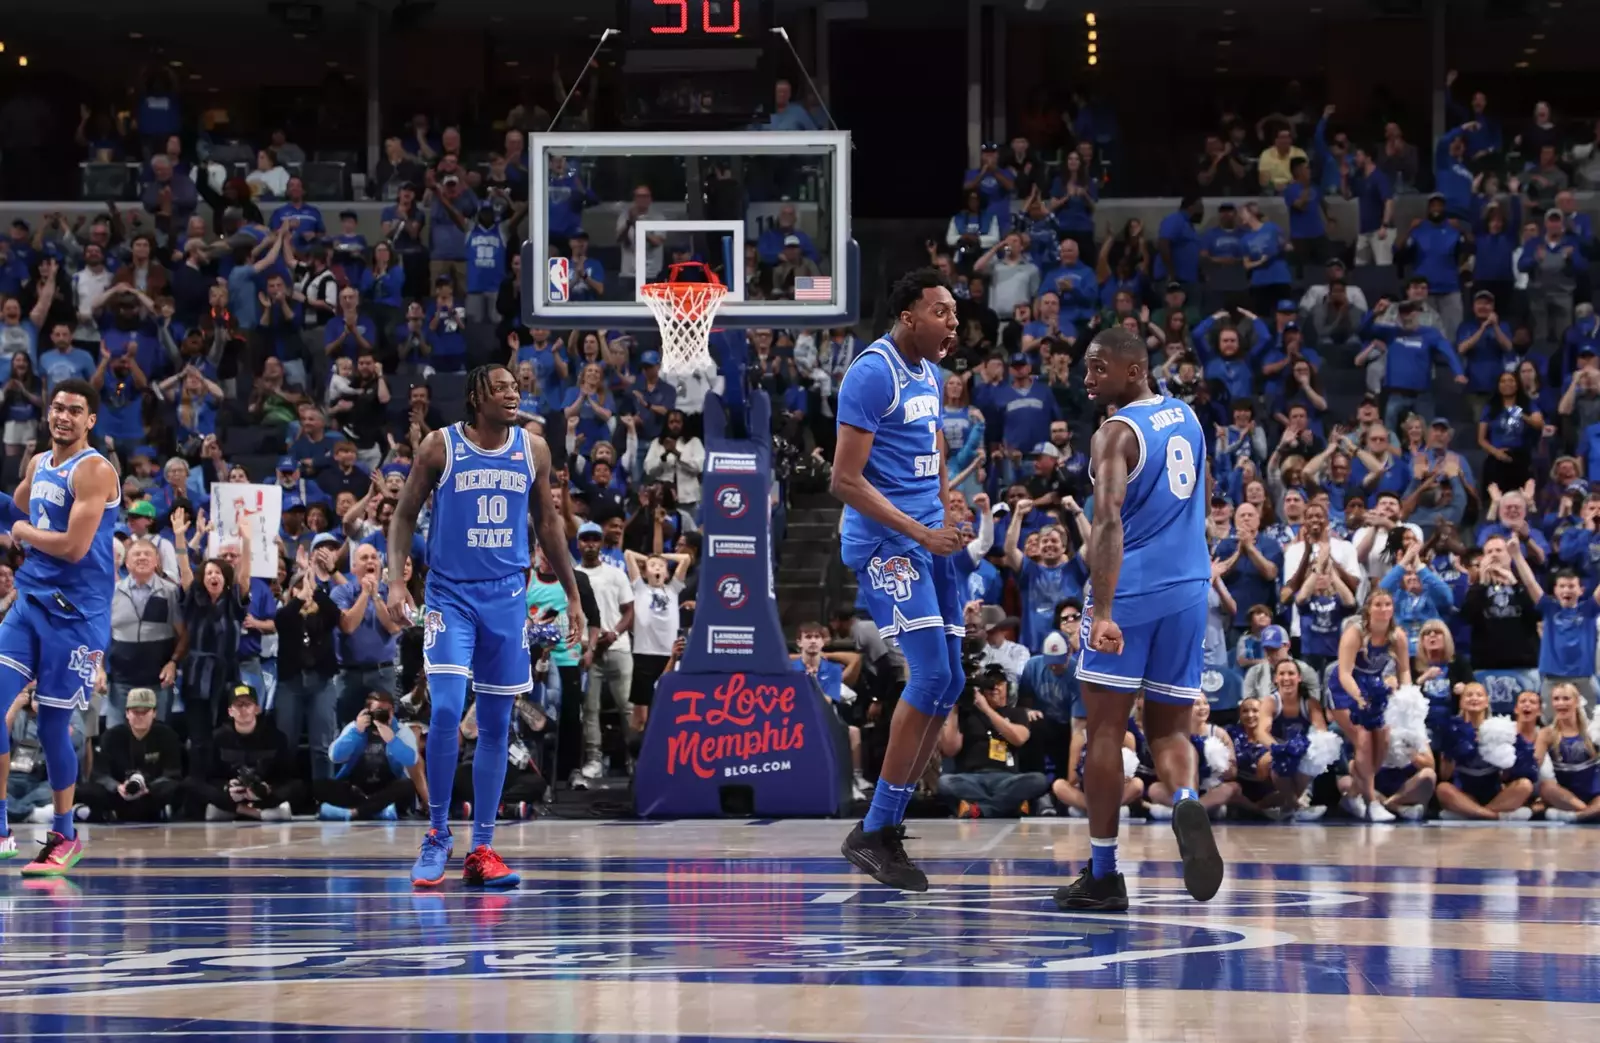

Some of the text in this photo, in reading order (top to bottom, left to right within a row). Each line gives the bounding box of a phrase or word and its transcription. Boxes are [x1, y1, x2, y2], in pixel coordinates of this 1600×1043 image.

[1148, 407, 1186, 431] JONES
[715, 458, 756, 466] LANDMARK
[1166, 435, 1197, 500] 8
[455, 469, 527, 493] MEMPHIS
[477, 495, 507, 524] 10
[723, 492, 741, 507] 24
[467, 528, 513, 547] STATE
[723, 583, 741, 598] 24
[868, 565, 912, 602] MSU
[714, 632, 754, 640] LANDMARK
[673, 673, 796, 726] I Love
[667, 717, 805, 778] Memphis
[724, 760, 791, 777] BLOG.COM
